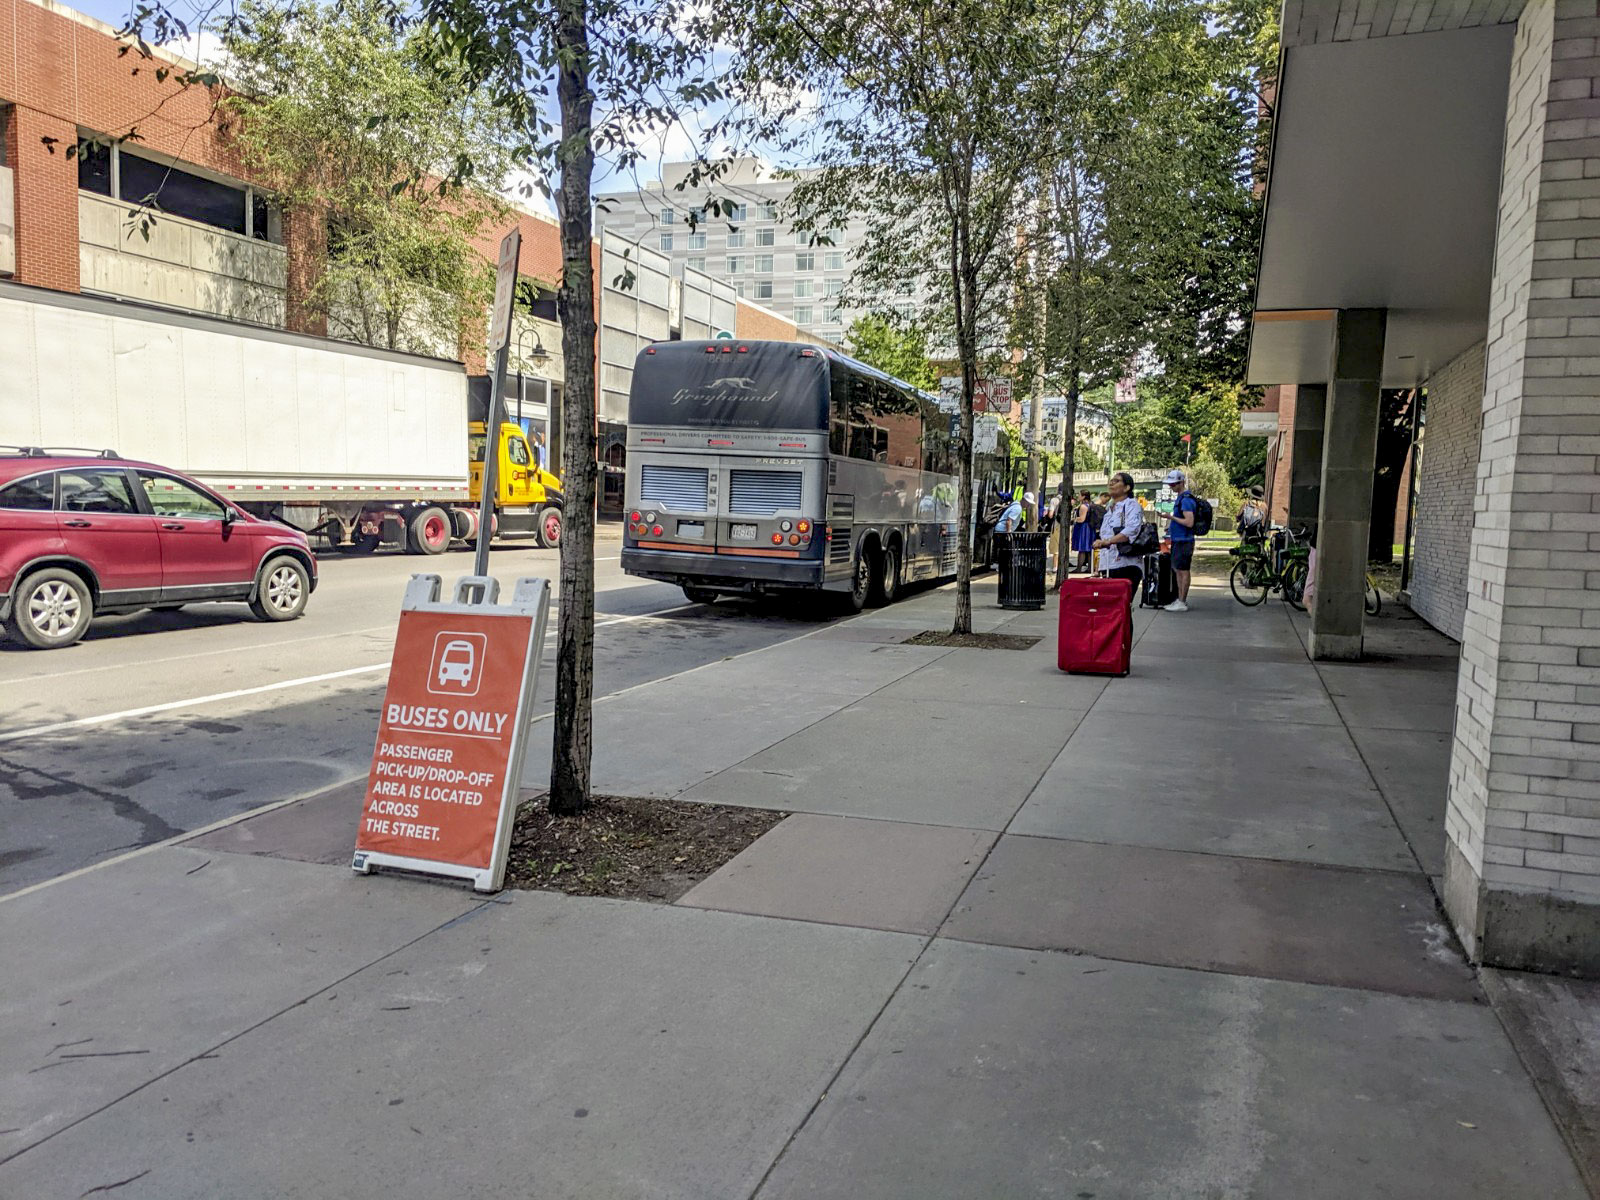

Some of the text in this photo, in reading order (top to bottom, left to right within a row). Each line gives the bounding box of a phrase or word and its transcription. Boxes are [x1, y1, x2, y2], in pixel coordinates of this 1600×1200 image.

[671, 388, 779, 406] Greyhound
[991, 395, 1010, 404] STOP
[993, 387, 1009, 395] BUS
[386, 704, 508, 734] BUSES ONLY
[379, 743, 454, 763] PASSENGER
[376, 761, 495, 787] PICK-UP/DROP-OFF
[372, 780, 483, 806] AREA IS LOCATED
[368, 799, 419, 819] ACROSS
[366, 818, 440, 841] THE STREET.
